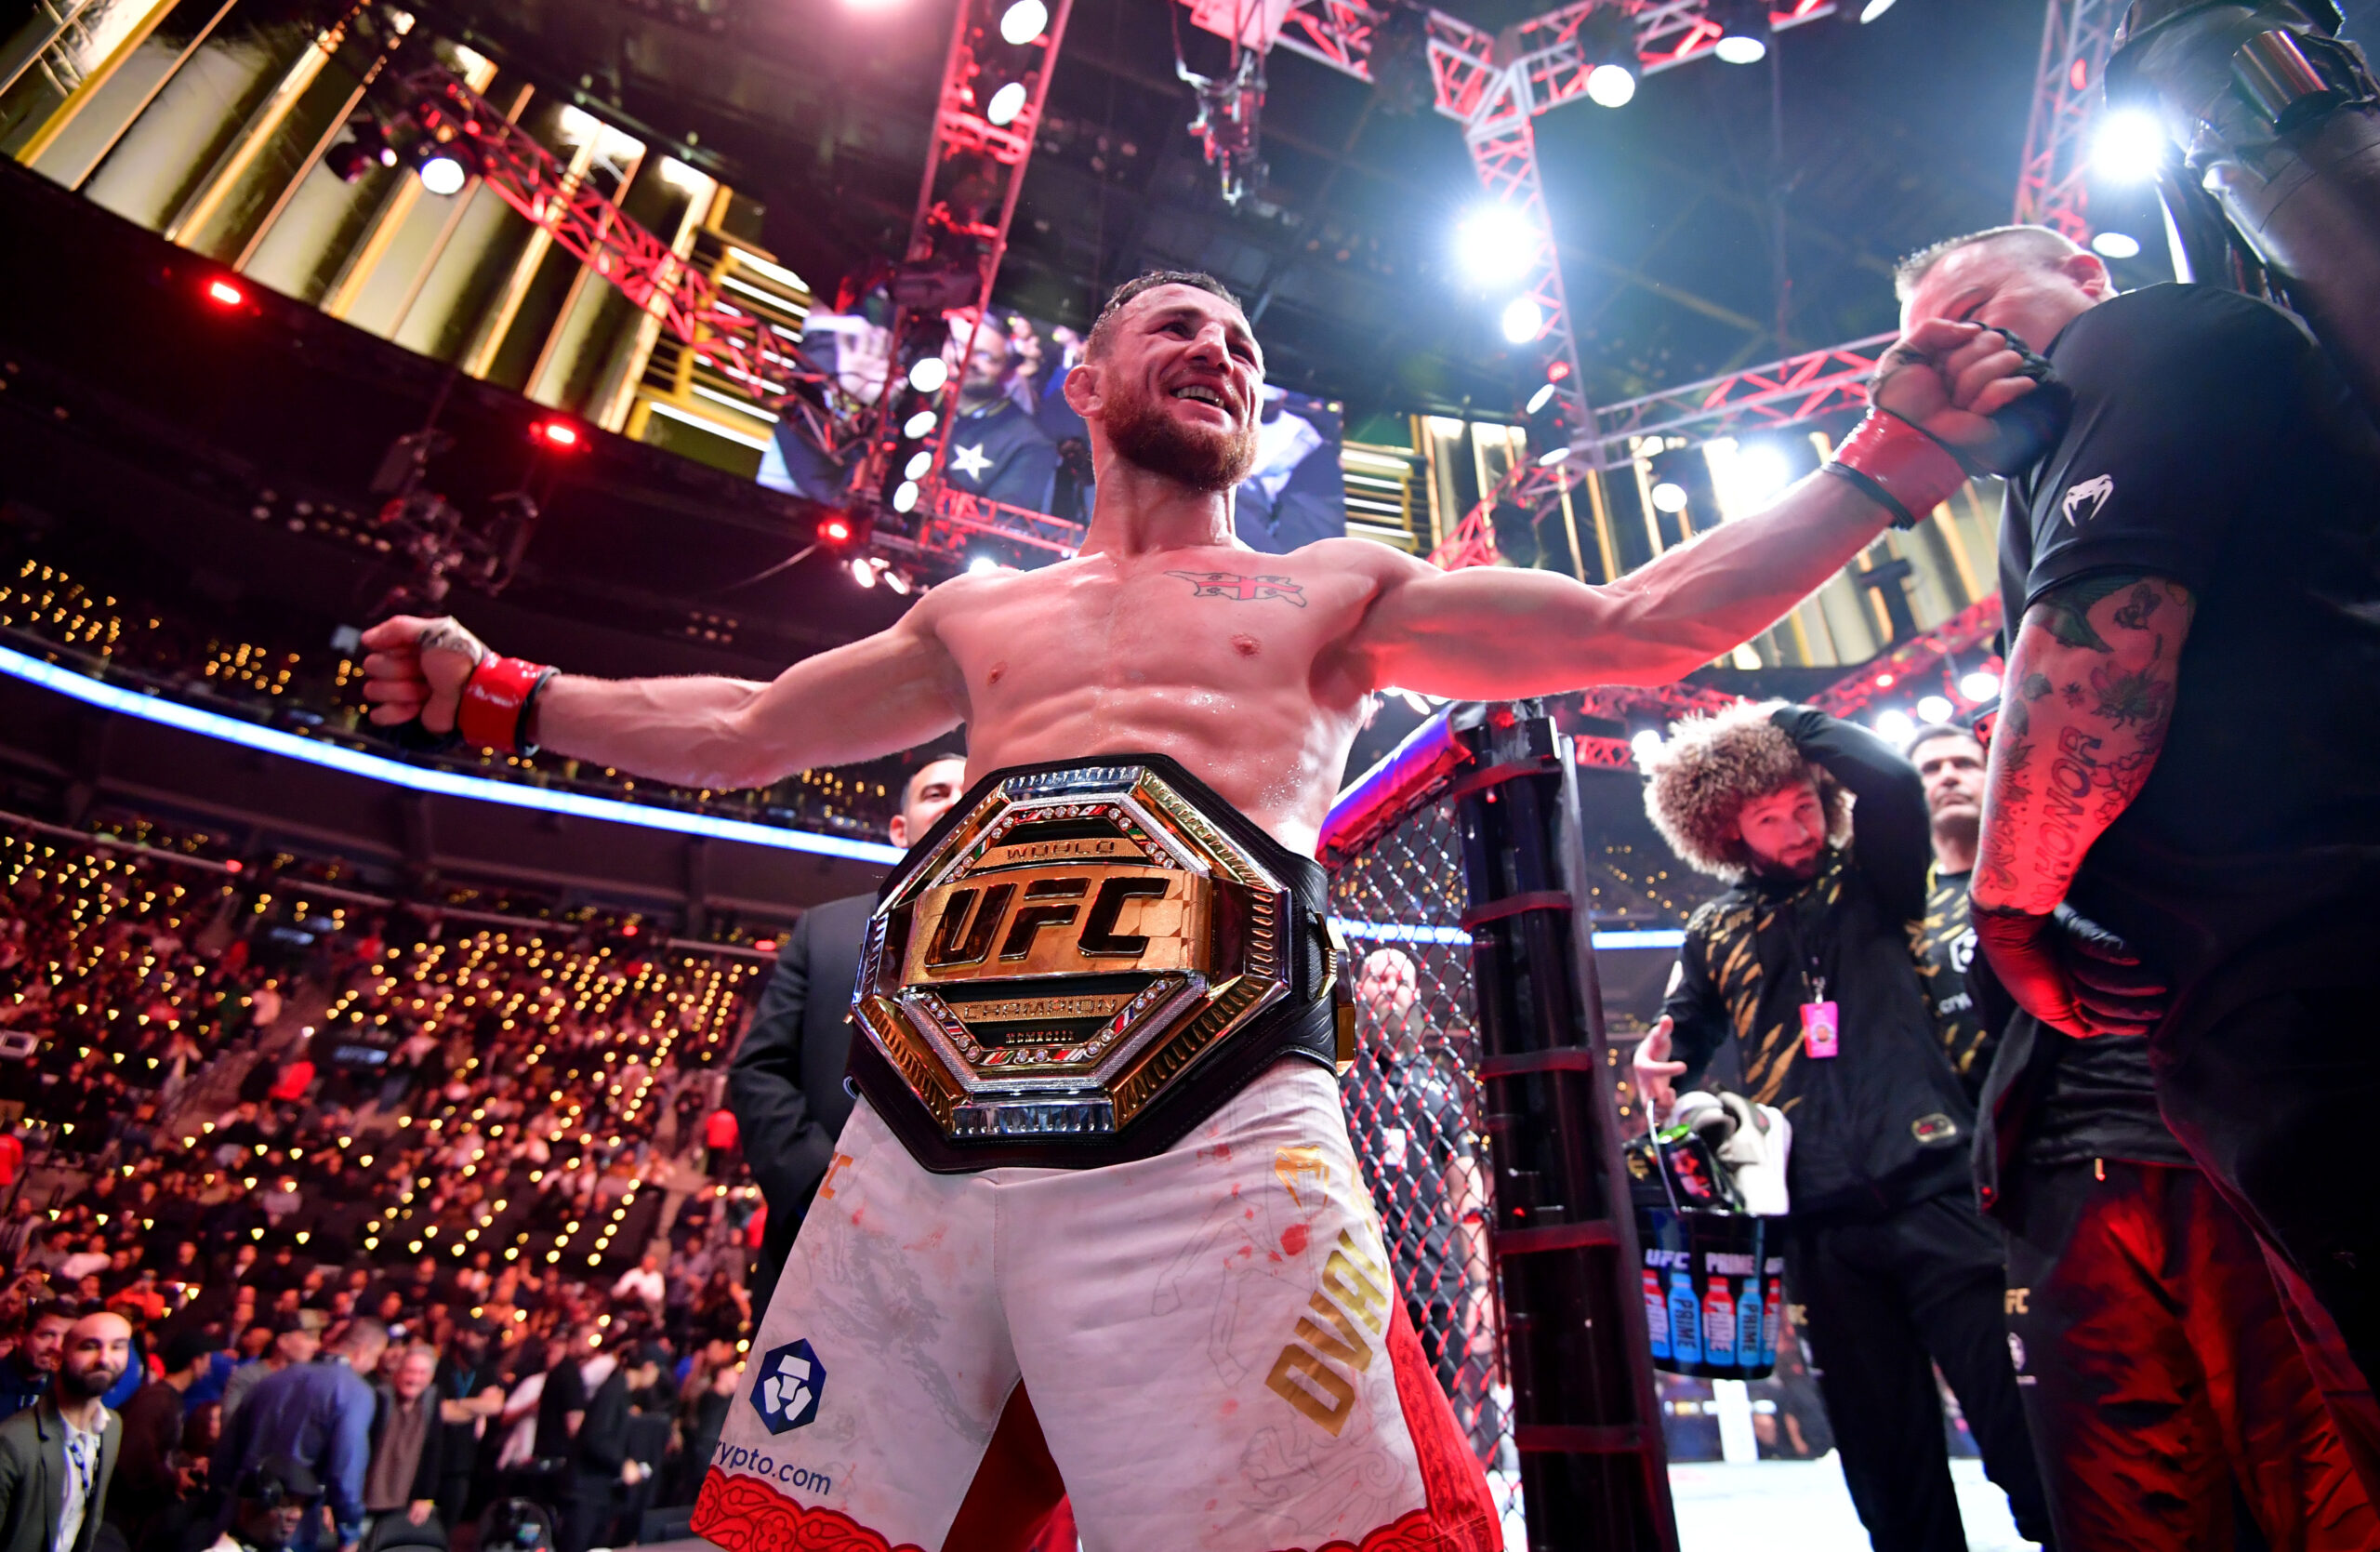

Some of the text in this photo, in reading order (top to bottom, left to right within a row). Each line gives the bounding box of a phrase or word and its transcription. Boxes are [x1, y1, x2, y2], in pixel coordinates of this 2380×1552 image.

[2033, 725, 2102, 882] HONOR
[1007, 841, 1115, 860] WORLD
[923, 877, 1170, 968] UFC
[964, 999, 1117, 1019] CHAMPION
[1645, 1248, 1690, 1270] UFC
[1705, 1252, 1755, 1275] PRIME
[1673, 1297, 1697, 1349] PRIME
[2004, 1288, 2030, 1315] FC
[1742, 1303, 1759, 1353] PRIME
[717, 1440, 831, 1495] rypto.com
